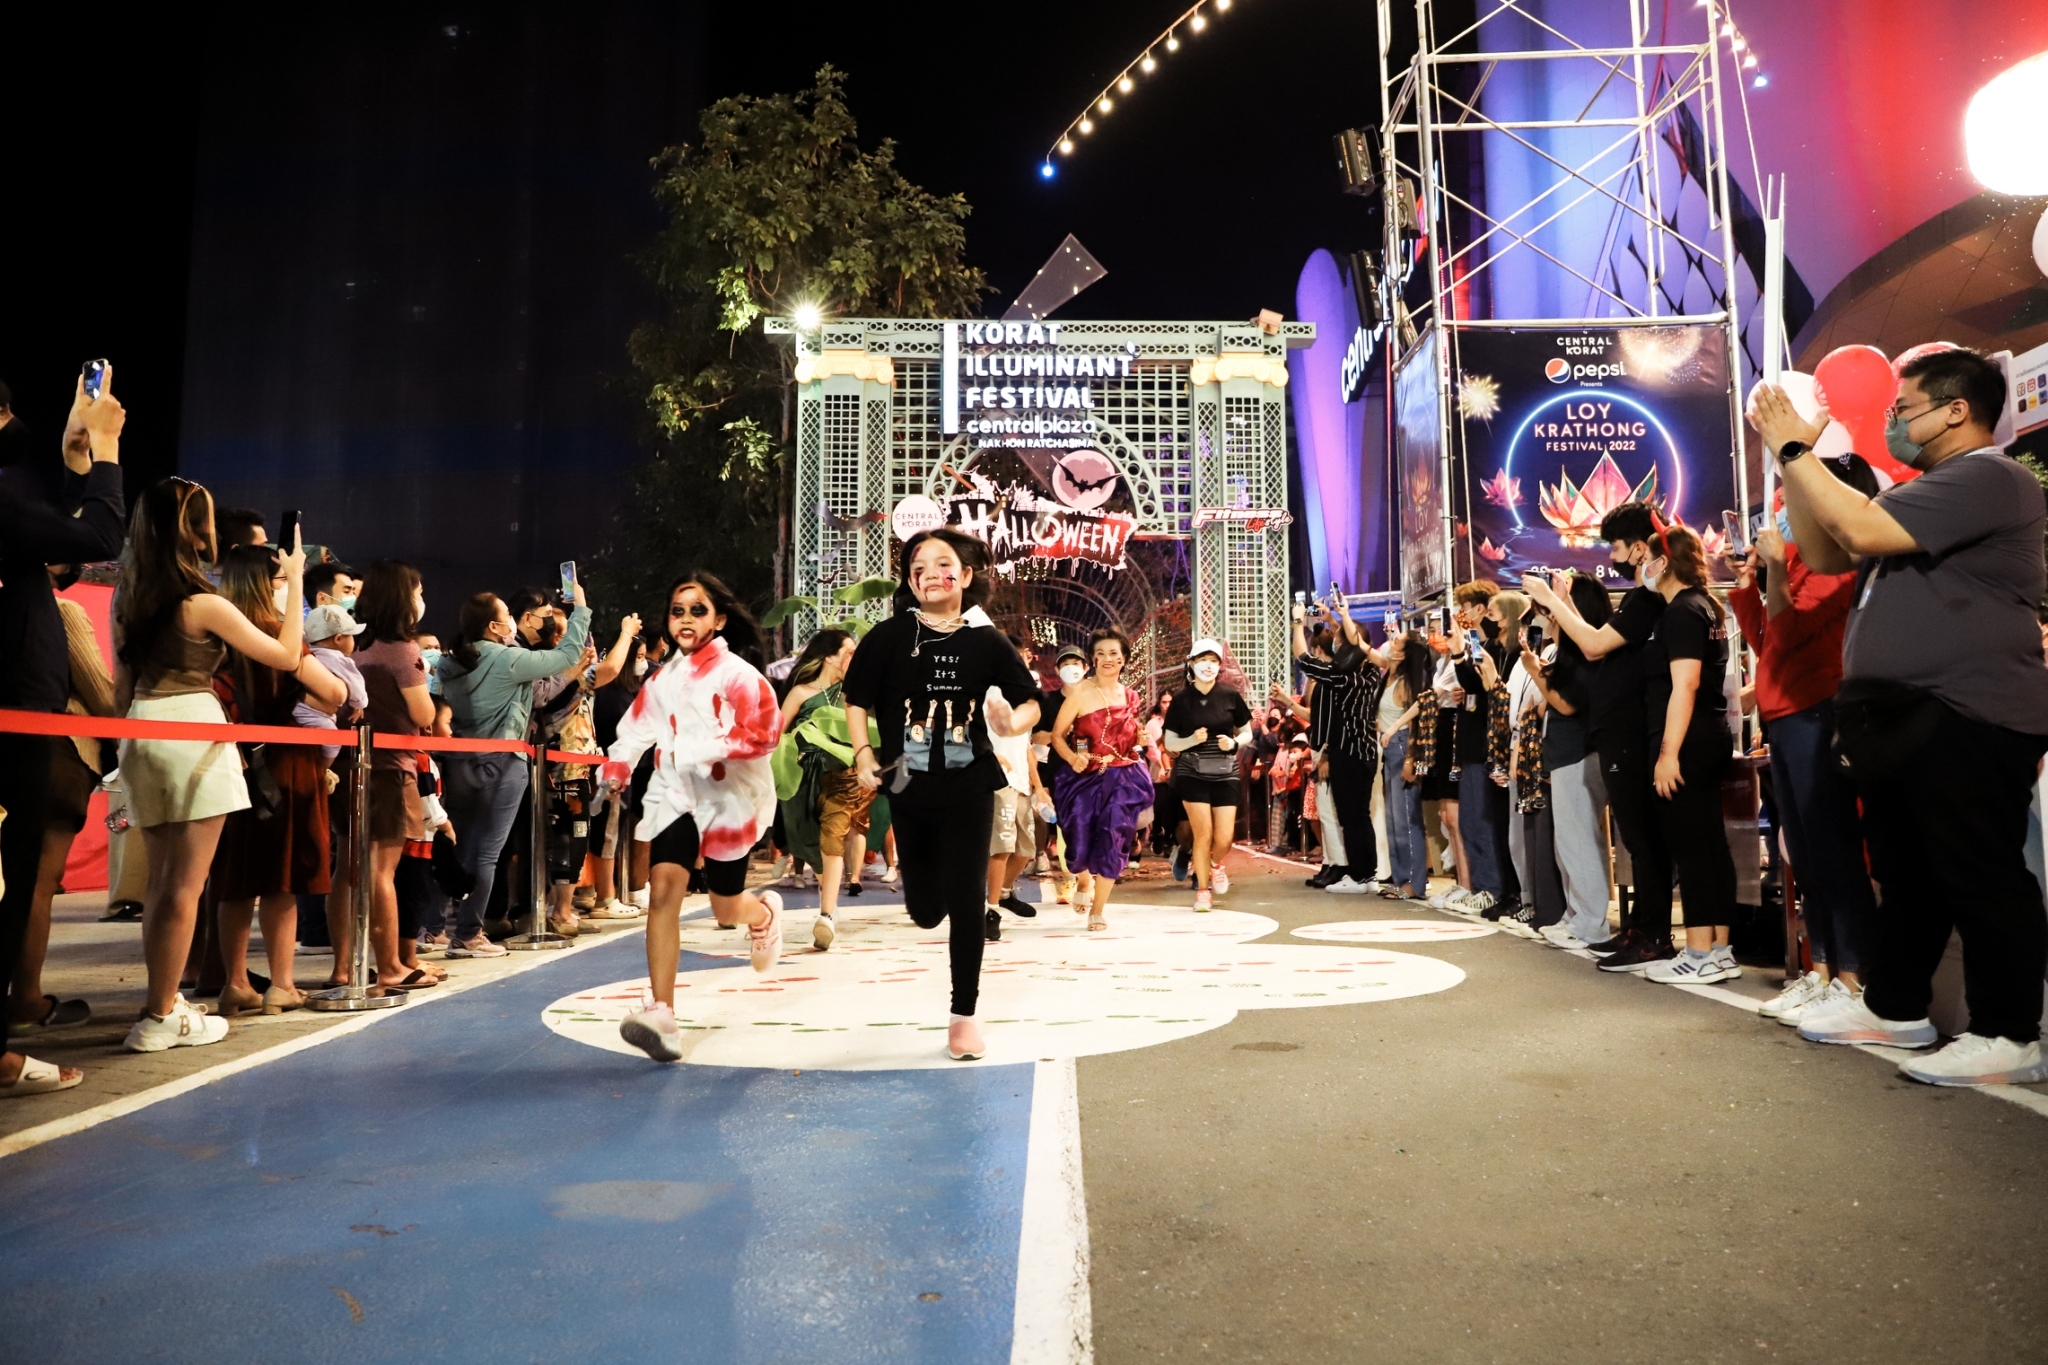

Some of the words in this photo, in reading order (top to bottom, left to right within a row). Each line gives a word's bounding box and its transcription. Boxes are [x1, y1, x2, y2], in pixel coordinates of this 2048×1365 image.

[966, 322, 1061, 345] KORAT
[1556, 337, 1613, 346] CENTRAL
[1566, 346, 1604, 355] KORAT
[966, 354, 1134, 377] ILLUMINANT
[1573, 361, 1624, 380] pepsi
[966, 386, 1096, 409] FESTIVAL
[1566, 402, 1611, 420] LOY
[966, 415, 1096, 438] centralplaza
[1534, 422, 1646, 438] KRATHONG
[978, 438, 1025, 448] NAKHON
[1027, 438, 1094, 448] RATCHASIMA
[1546, 441, 1603, 451] FESTIVAL
[1609, 441, 1636, 451] 2022
[956, 502, 1120, 557] HALLOWEEN
[1596, 564, 1605, 578] 8
